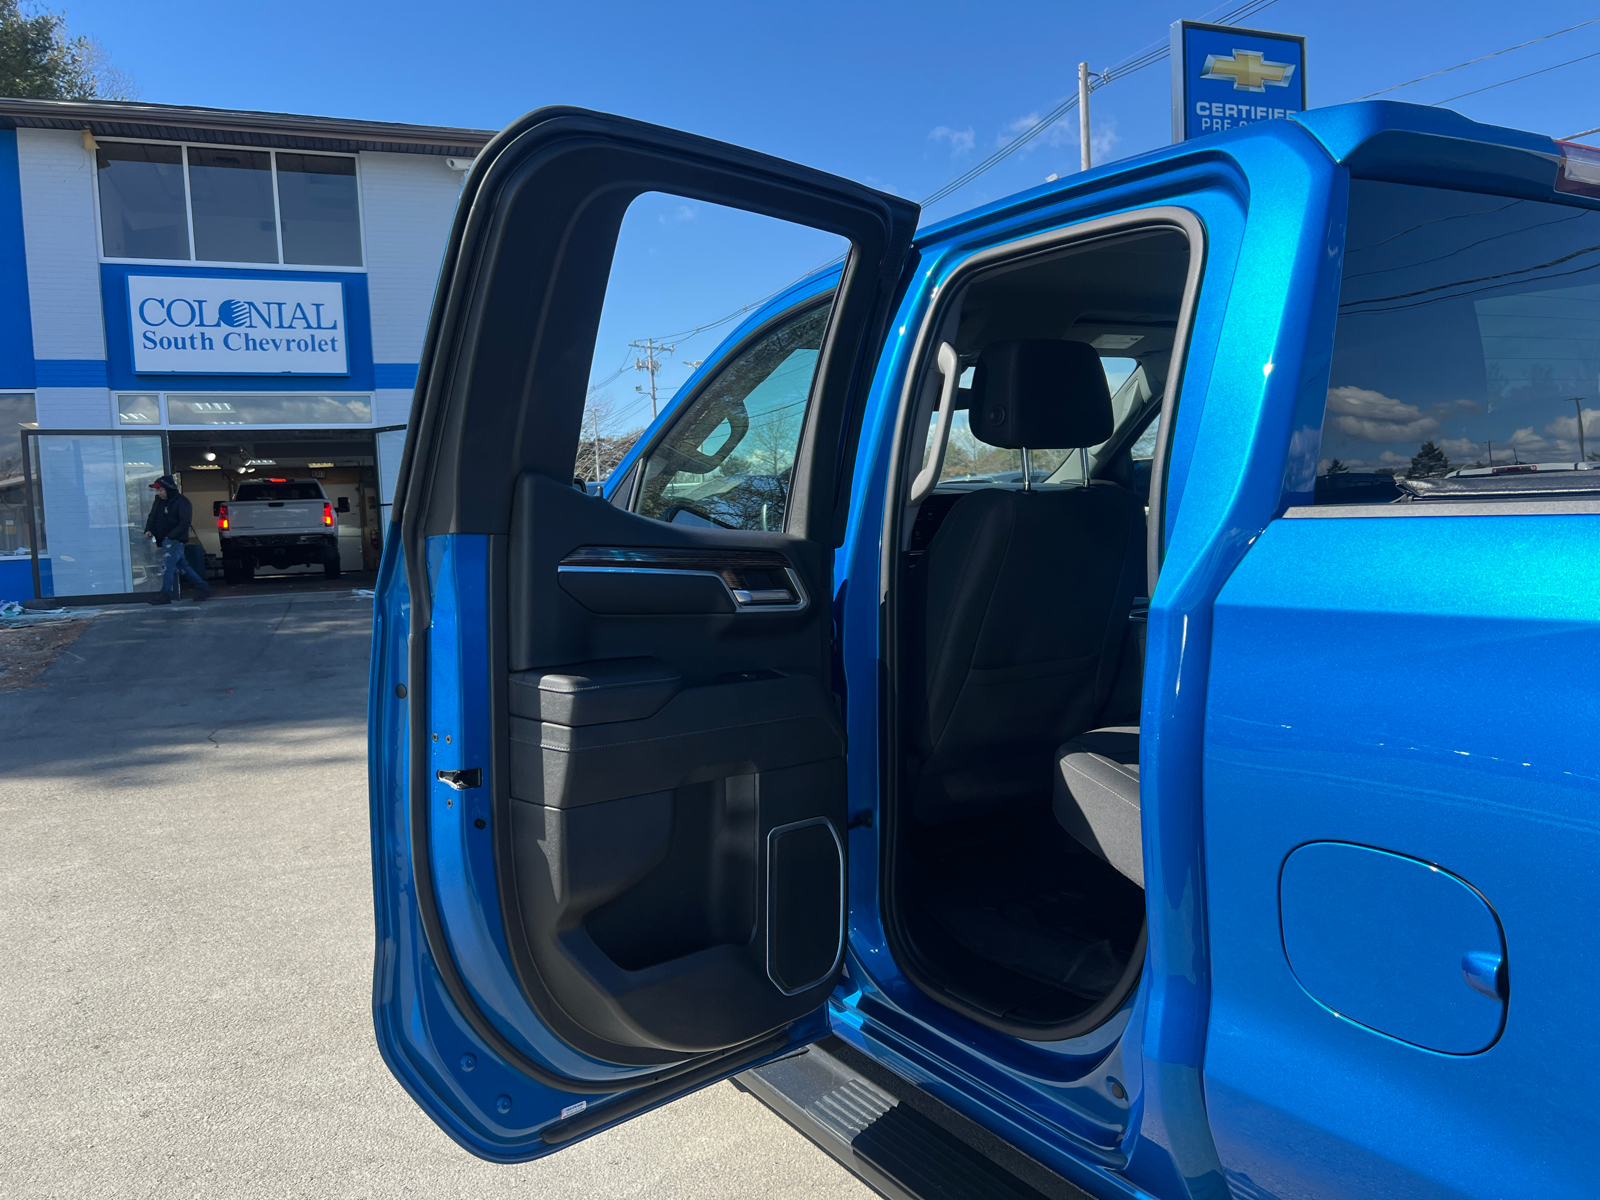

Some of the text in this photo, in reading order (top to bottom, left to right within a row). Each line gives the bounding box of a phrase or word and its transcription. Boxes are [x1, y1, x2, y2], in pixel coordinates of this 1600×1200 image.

[138, 297, 338, 330] COLONIAL
[142, 330, 339, 353] South Chevrolet
